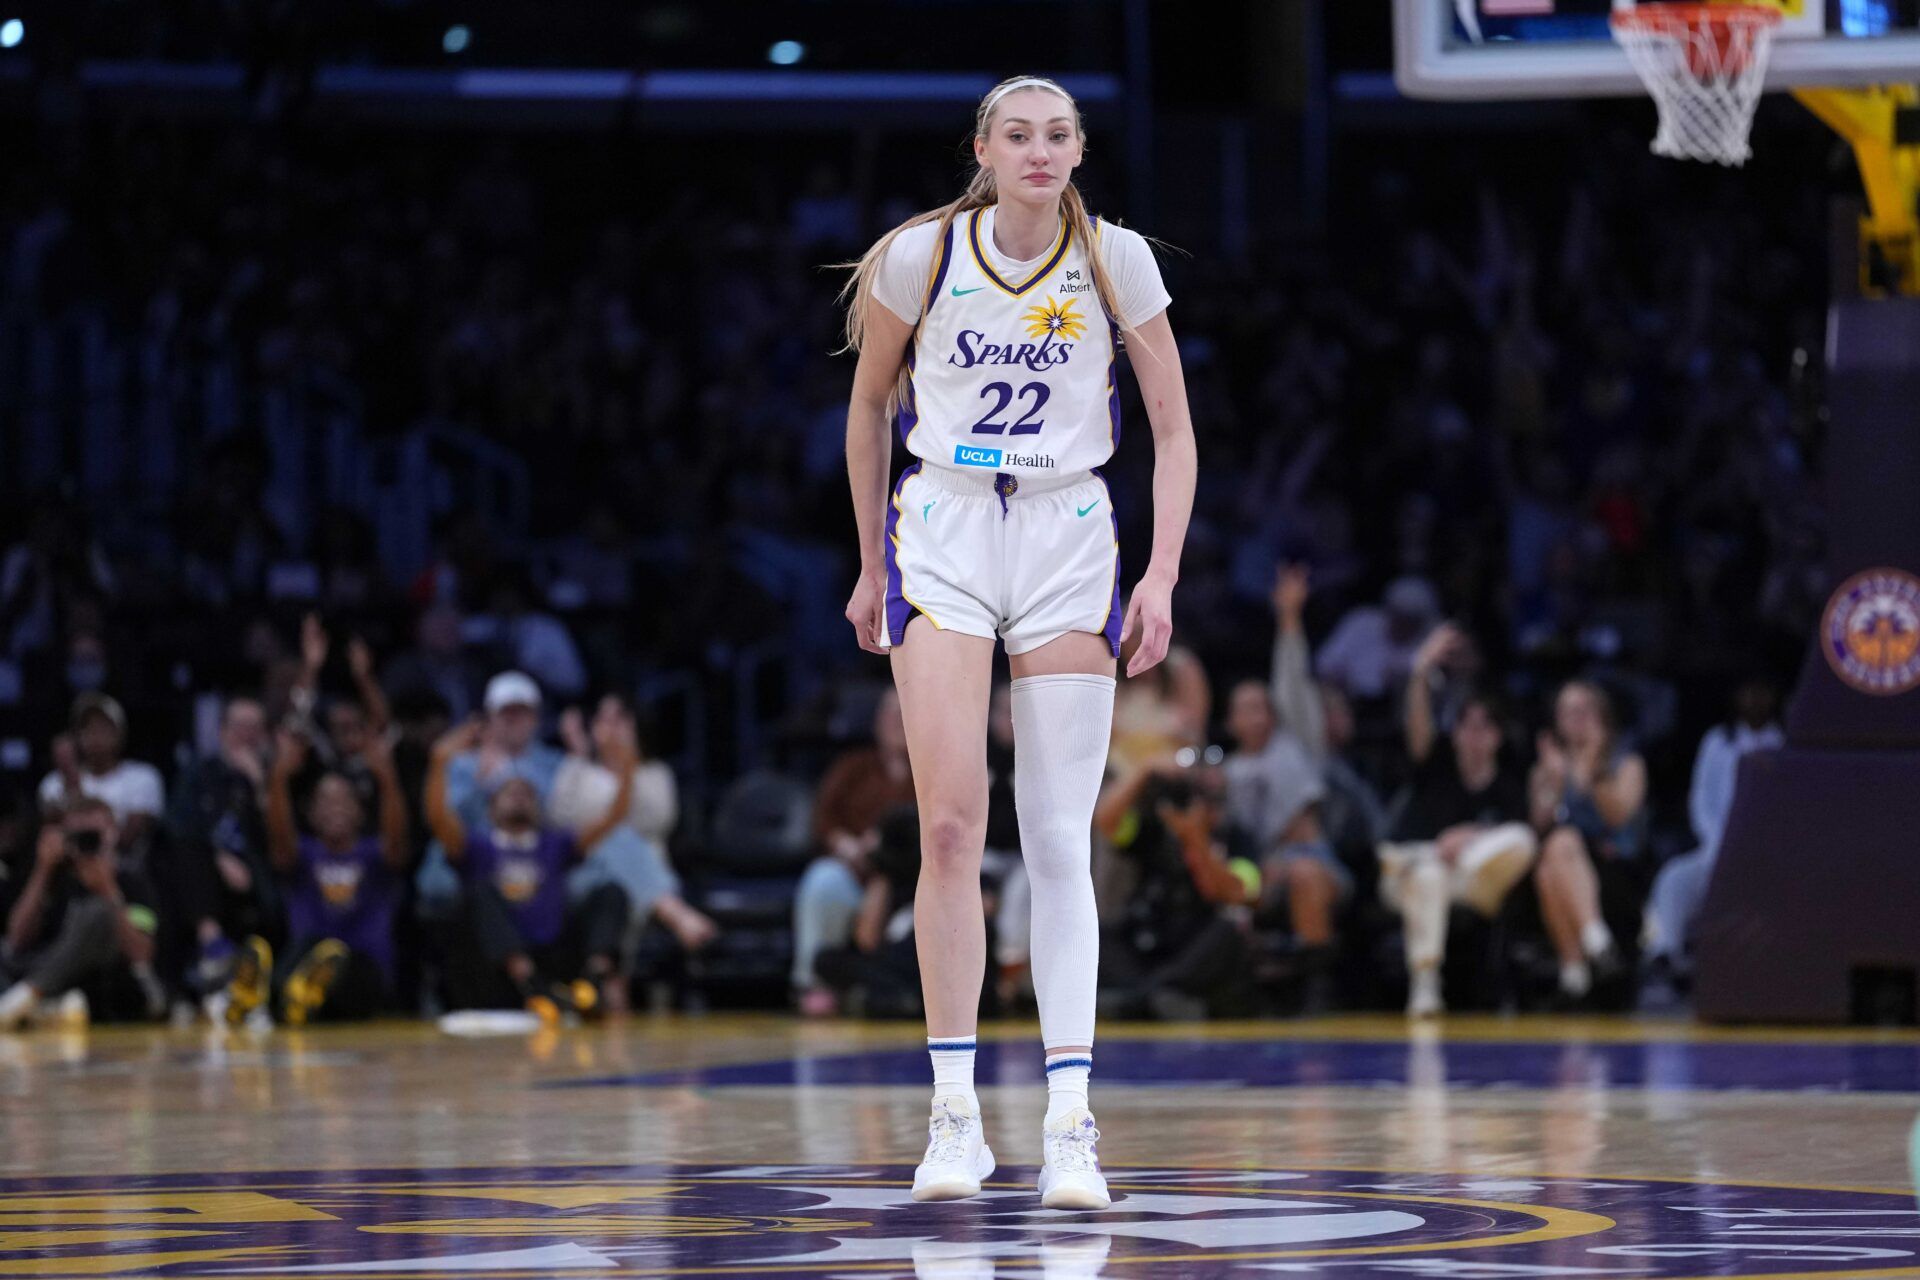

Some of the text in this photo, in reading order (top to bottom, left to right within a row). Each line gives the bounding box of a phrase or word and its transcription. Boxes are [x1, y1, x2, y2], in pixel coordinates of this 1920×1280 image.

[1060, 283, 1090, 293] Albert
[948, 329, 1074, 372] SPARKS
[971, 381, 1051, 436] 22
[961, 449, 1055, 468] UCLA Health
